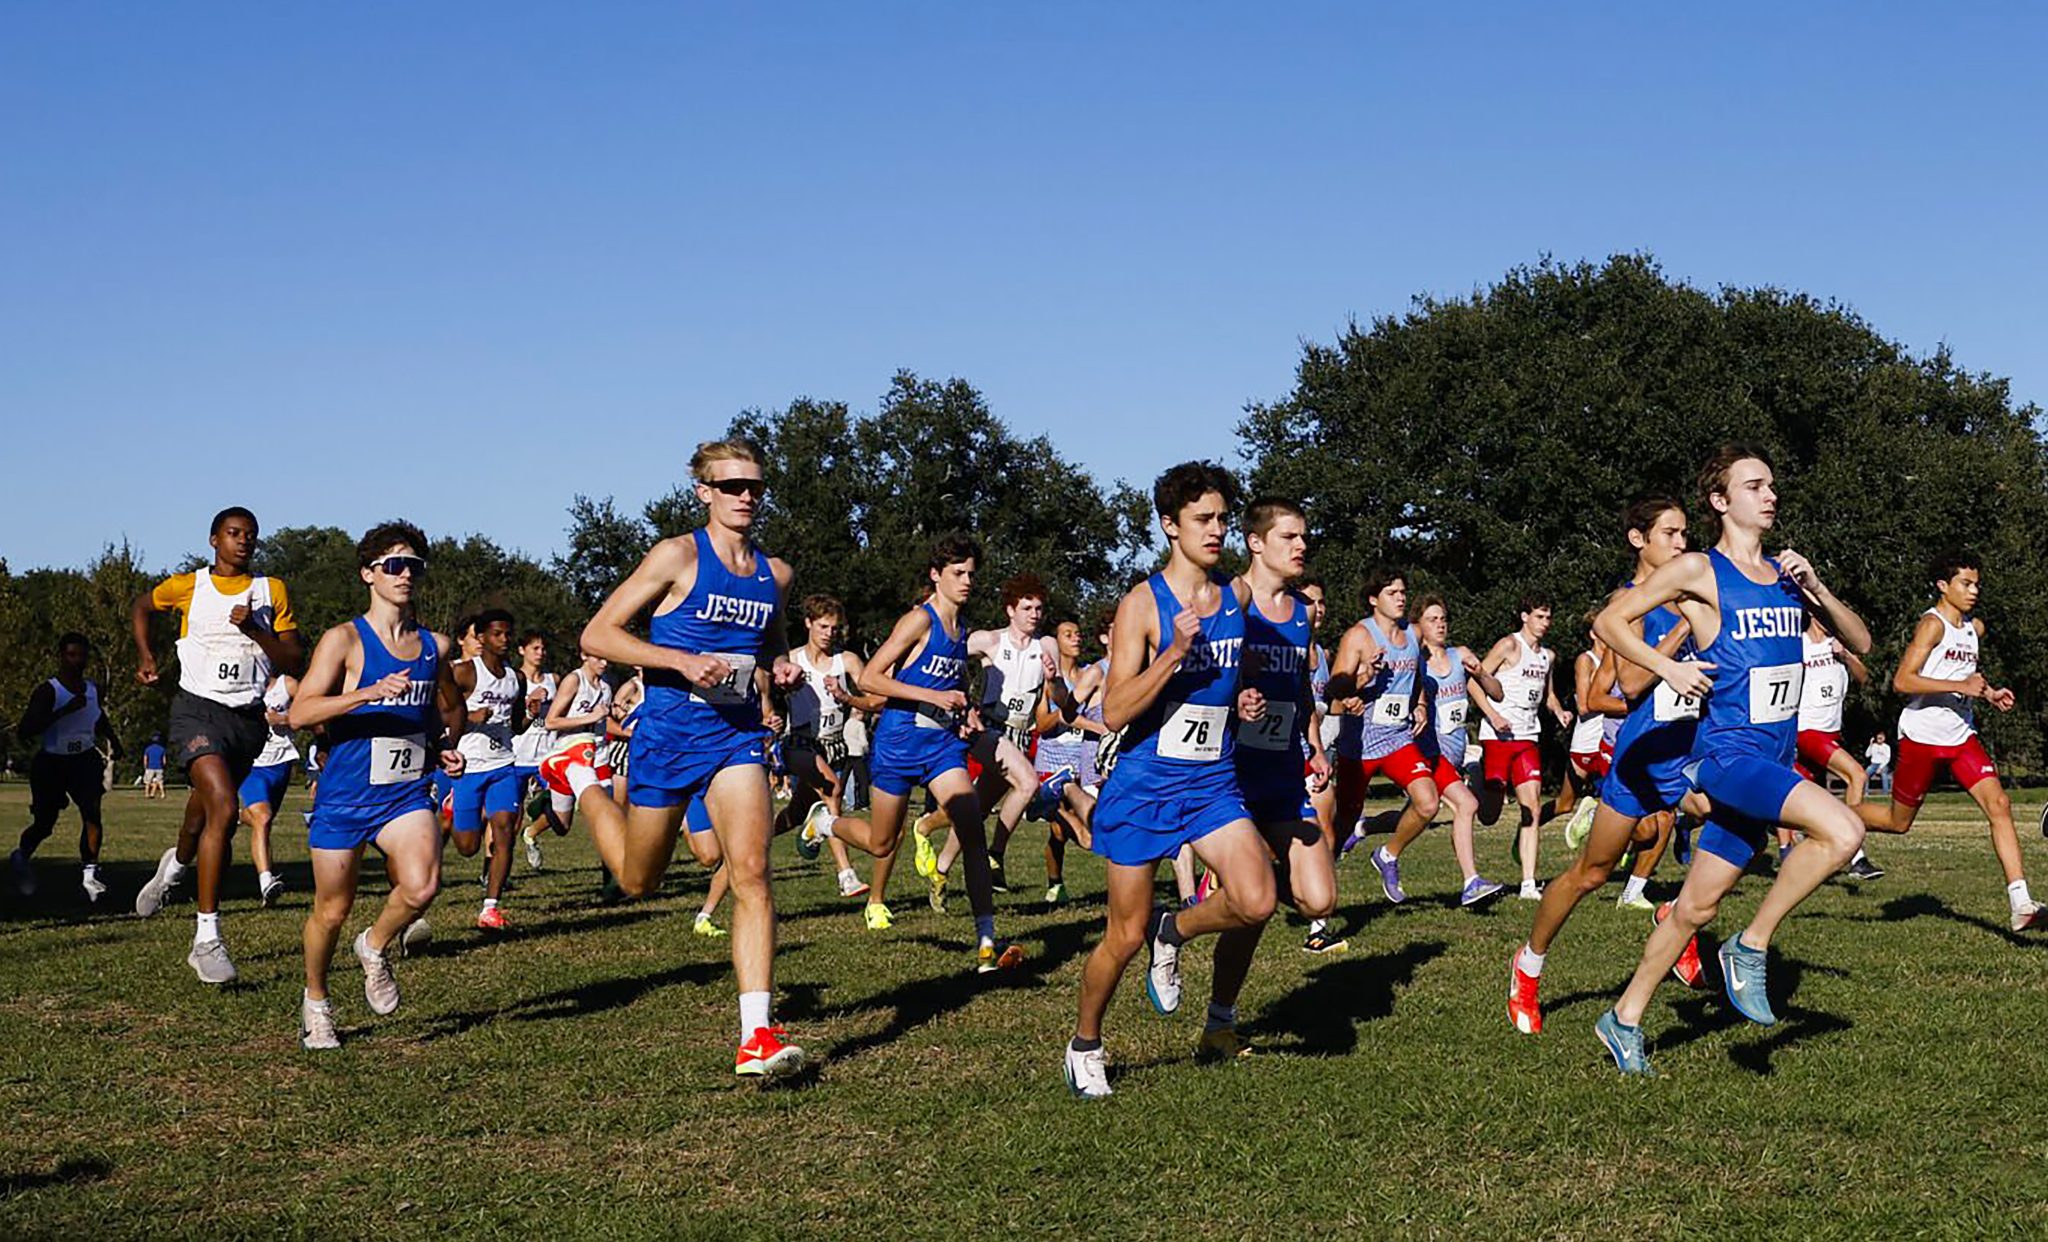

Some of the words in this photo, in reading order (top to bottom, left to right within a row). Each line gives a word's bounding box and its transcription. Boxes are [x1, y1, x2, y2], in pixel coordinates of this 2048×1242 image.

[696, 593, 773, 630] JESUIT
[218, 662, 240, 680] 94
[1769, 680, 1790, 706] 77
[1820, 685, 1834, 698] 52
[1007, 698, 1025, 713] 68
[1385, 702, 1401, 717] 49
[822, 712, 836, 728] 70
[1449, 709, 1462, 722] 45
[1182, 719, 1209, 745] 76
[1259, 714, 1283, 736] 72
[389, 748, 411, 770] 73
